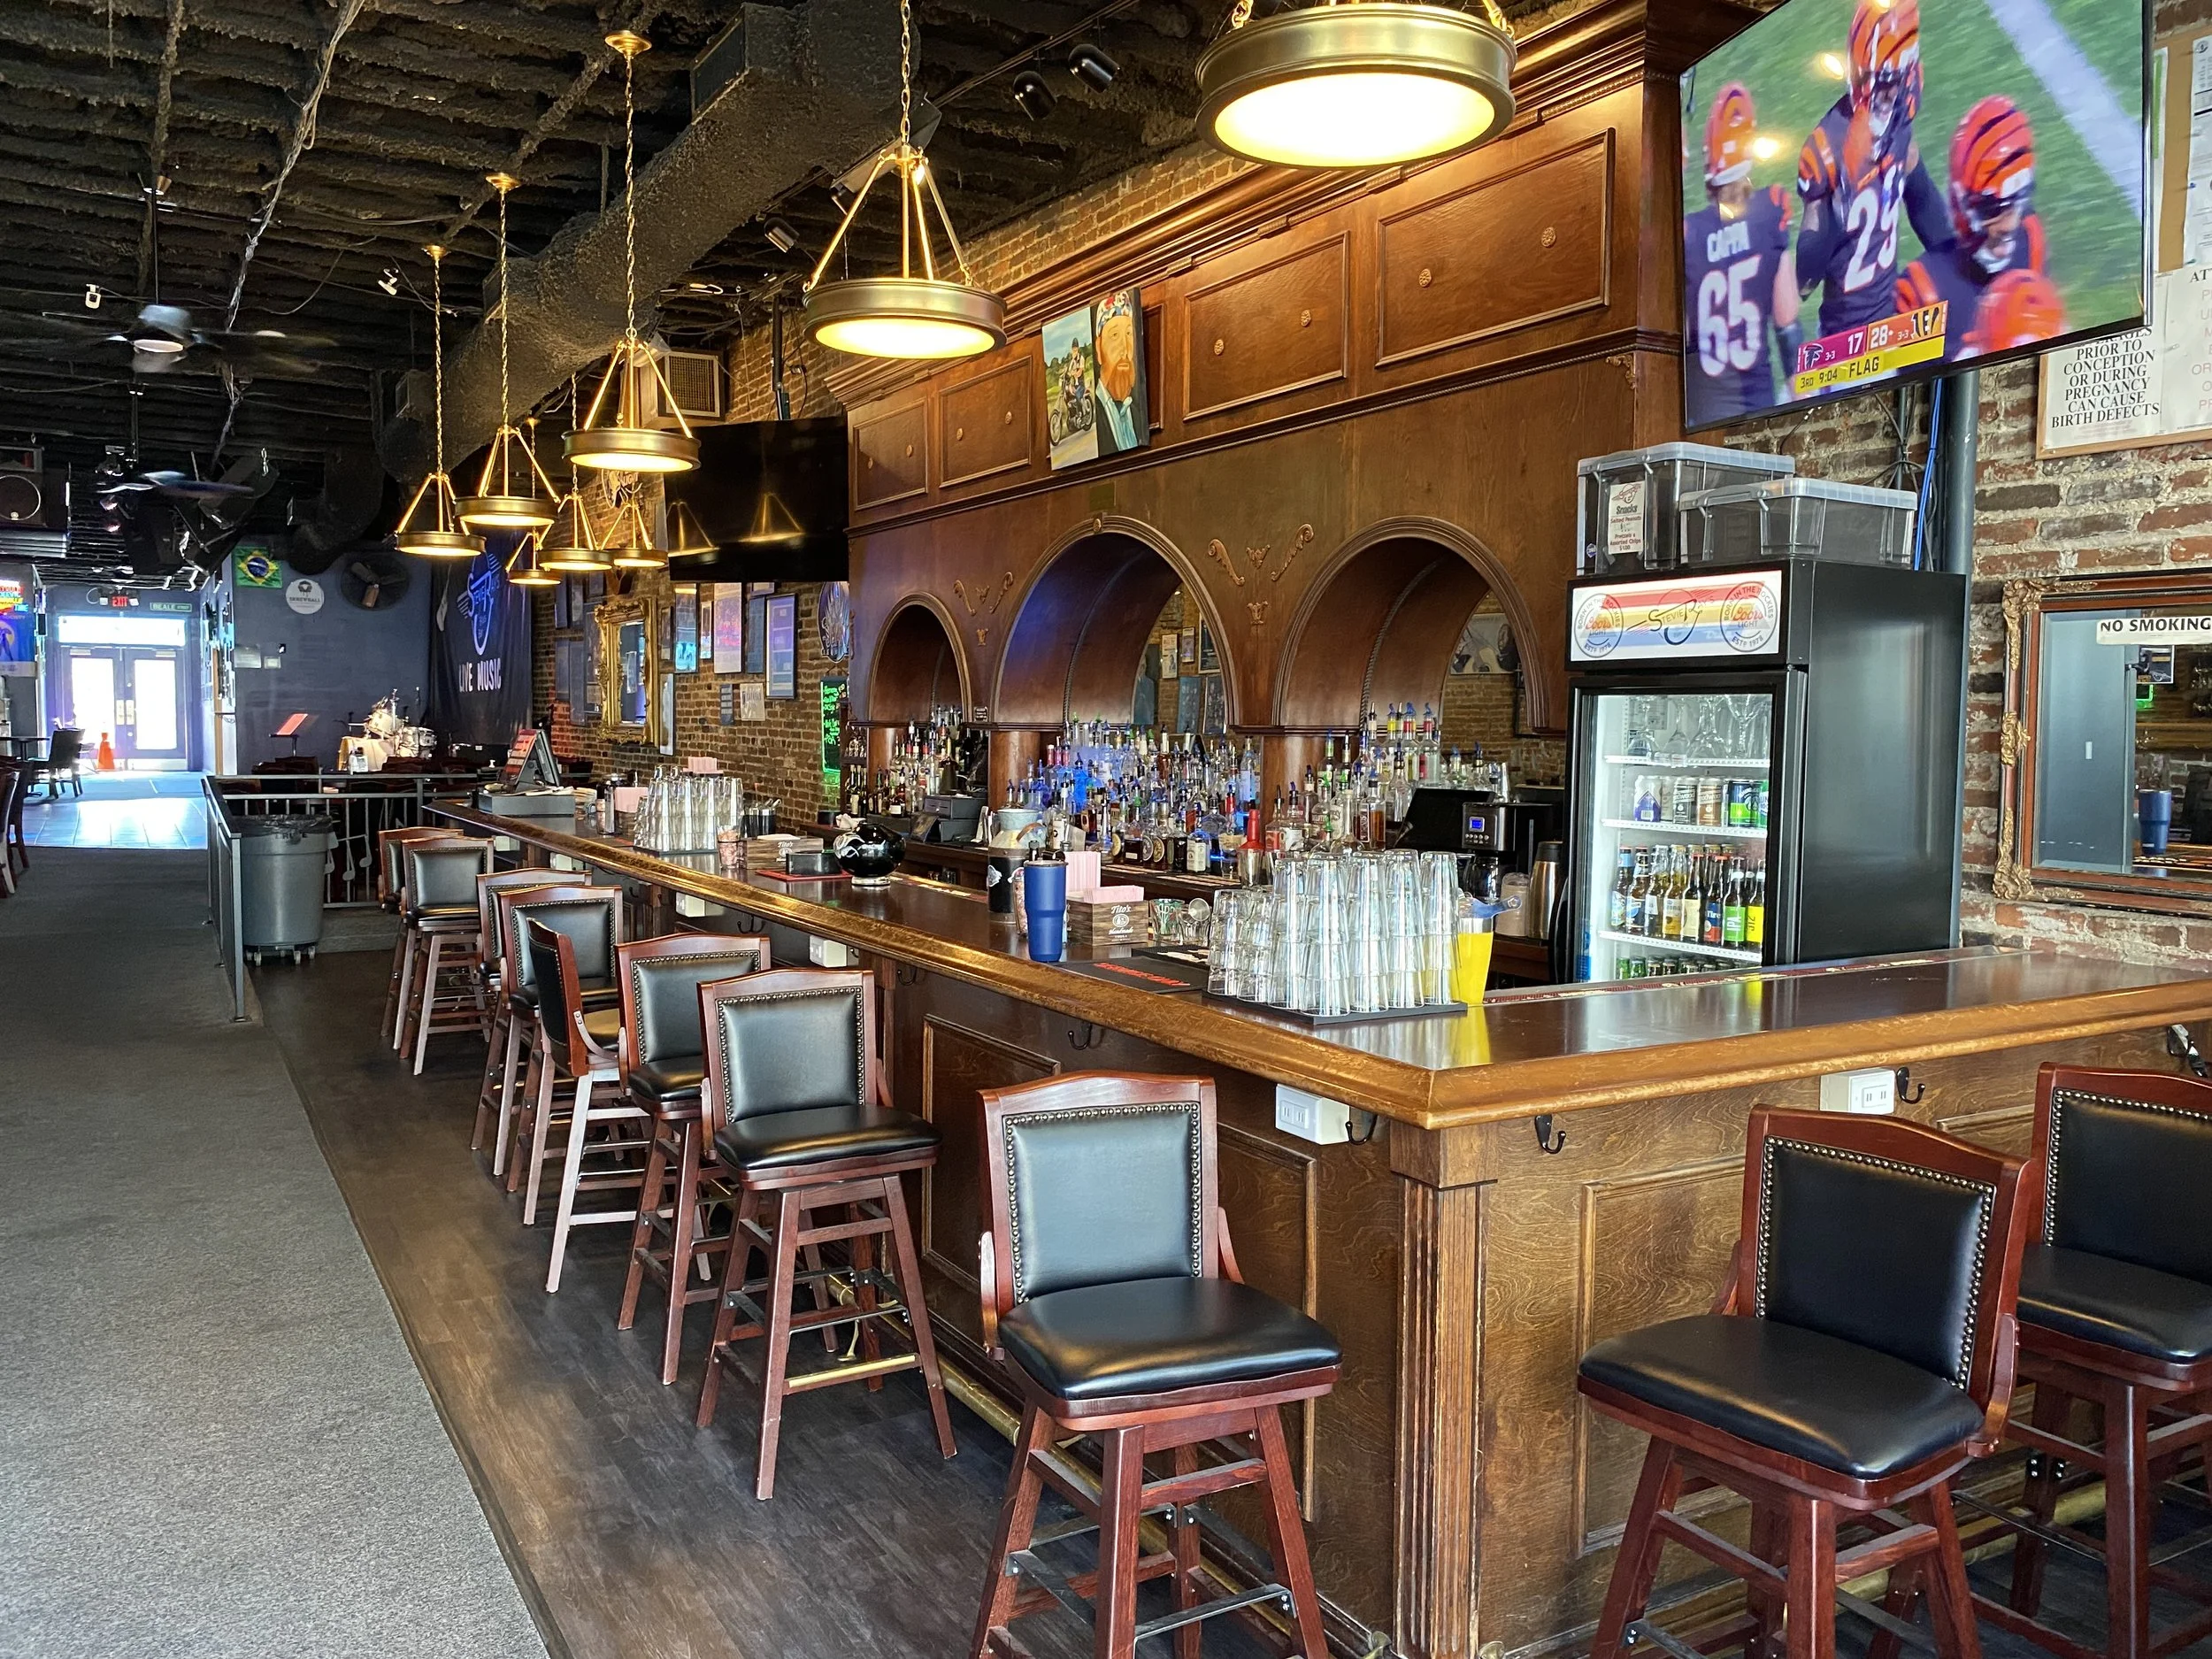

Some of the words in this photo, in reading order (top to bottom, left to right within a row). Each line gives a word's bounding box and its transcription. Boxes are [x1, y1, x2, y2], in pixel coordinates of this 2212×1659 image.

[1844, 163, 1902, 293] 29
[1698, 254, 1762, 377] 65
[1847, 331, 1863, 355] 17
[1870, 325, 1889, 349] 28
[2077, 342, 2119, 361] PRIOR
[2124, 338, 2142, 354] TO
[1801, 376, 1814, 389] 3RD
[1819, 367, 1838, 383] 9:04
[1849, 356, 1880, 379] FLAG
[2063, 349, 2156, 375] CONCEPTION
[2070, 373, 2089, 388] OR
[2093, 364, 2147, 386] DURING
[2065, 376, 2151, 401] PREGNANCY
[2068, 397, 2098, 414] CAN
[2101, 390, 2146, 410] CAUSE
[2051, 413, 2093, 428] BIRTH
[1616, 503, 1638, 515] Snacks
[112, 595, 127, 607] EXIT
[1724, 597, 1734, 621] BORN
[1733, 589, 1742, 599] IN
[1755, 588, 1774, 619] ROCKIES
[1578, 608, 1587, 629] BORN
[1732, 606, 1764, 621] Coors
[2101, 619, 2124, 632] NO
[2129, 618, 2212, 632] SMOKING
[1749, 634, 1763, 647] 1978
[458, 662, 473, 693] LIVE
[477, 657, 502, 691] MUSIC
[1111, 904, 1132, 914] Tito's
[1726, 916, 1742, 932] IPA
